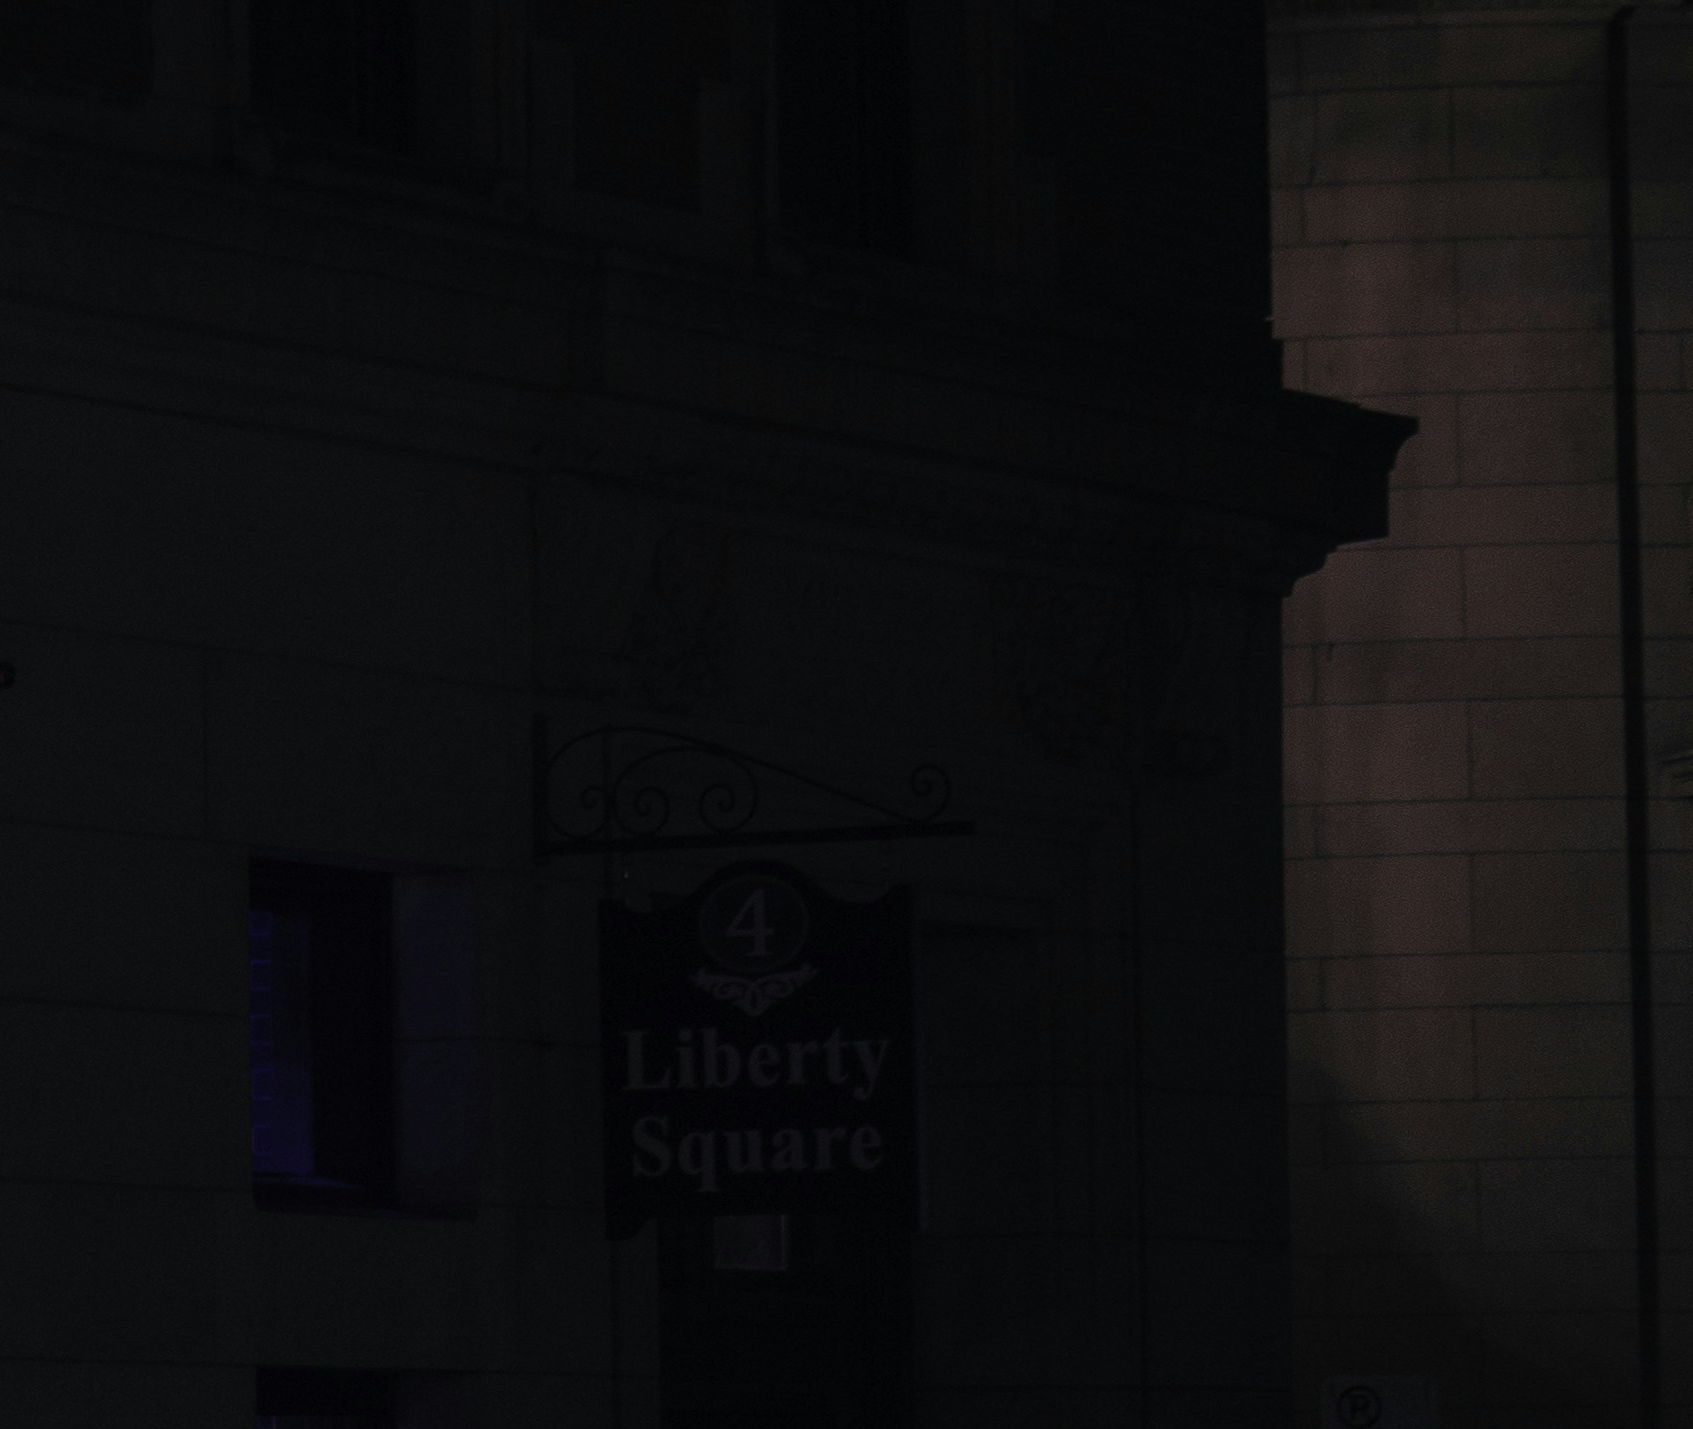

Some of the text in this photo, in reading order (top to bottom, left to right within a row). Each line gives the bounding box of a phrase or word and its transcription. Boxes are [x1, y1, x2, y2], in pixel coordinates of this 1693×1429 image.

[724, 889, 774, 957] 4
[621, 1026, 893, 1100] Liberty
[631, 1114, 885, 1193] Square
